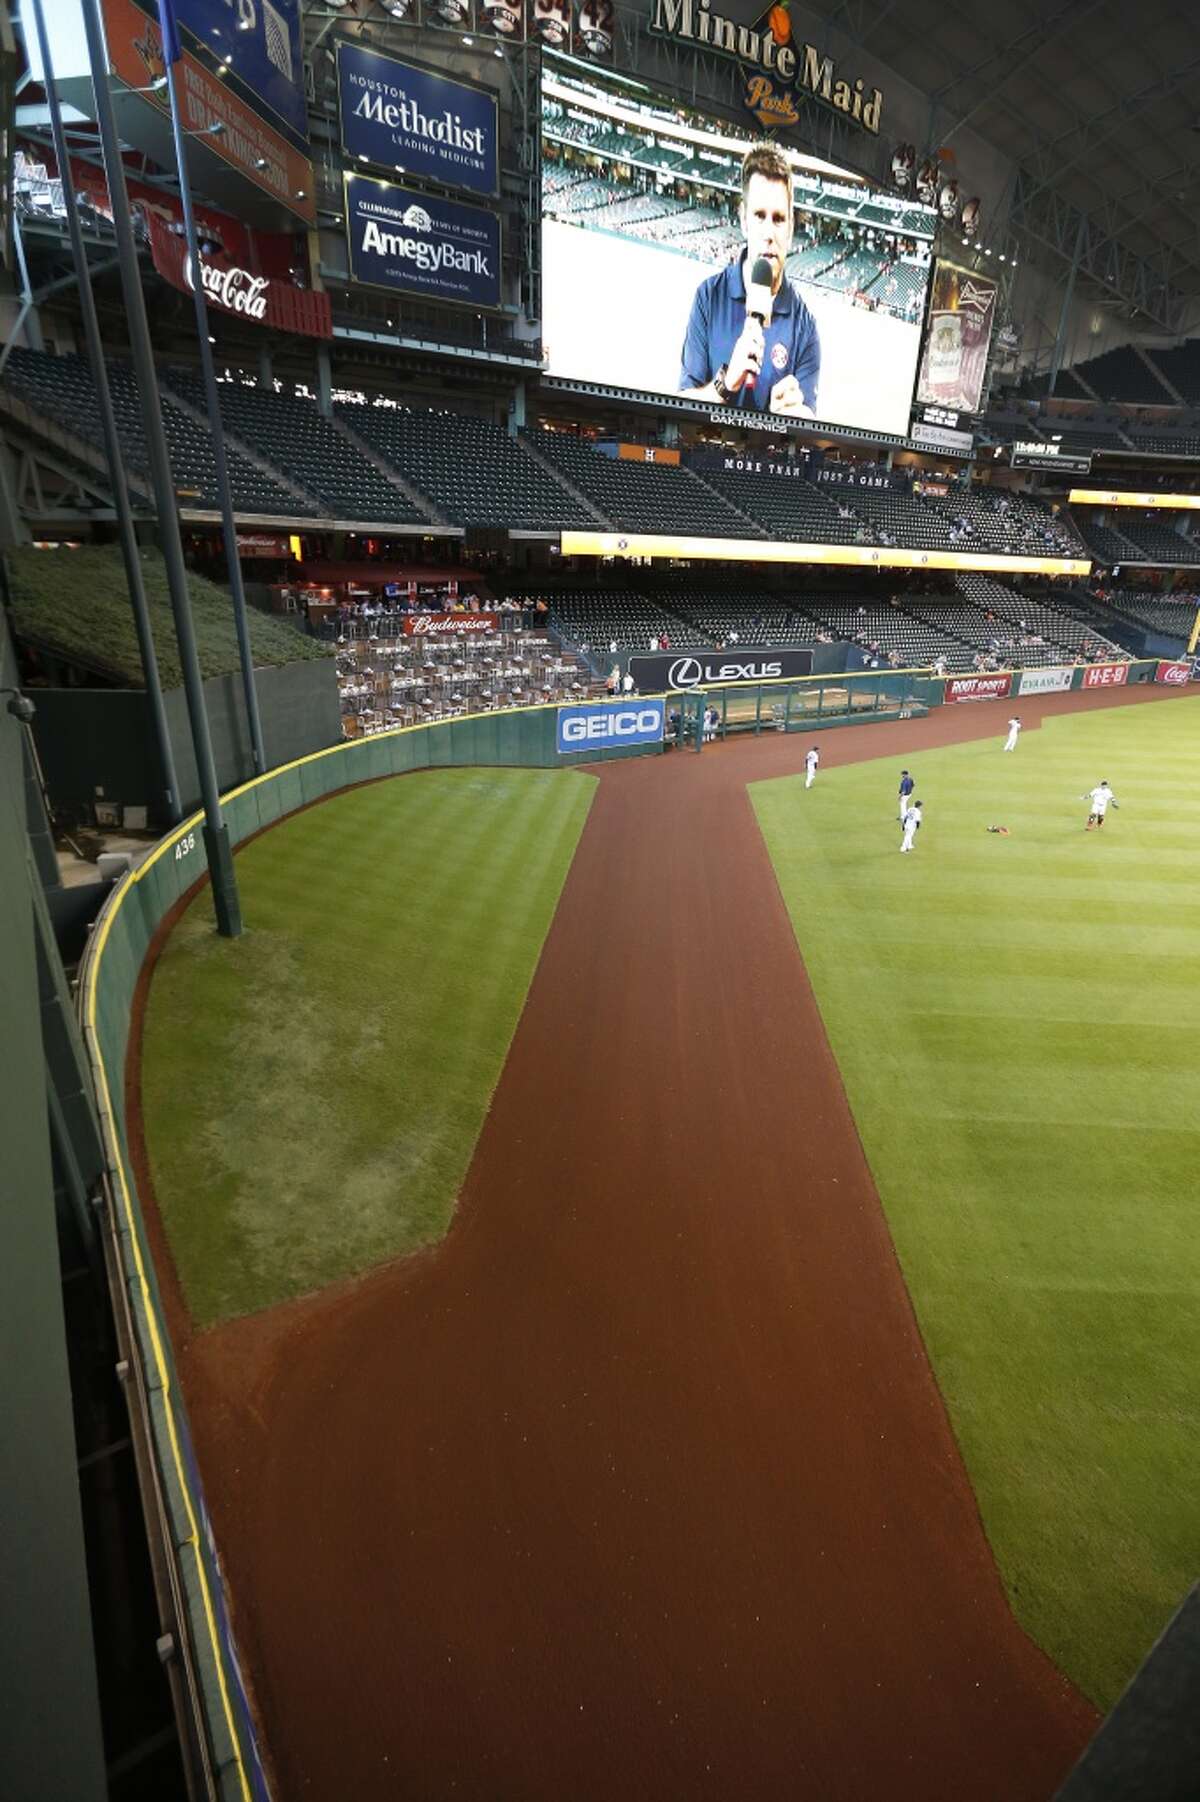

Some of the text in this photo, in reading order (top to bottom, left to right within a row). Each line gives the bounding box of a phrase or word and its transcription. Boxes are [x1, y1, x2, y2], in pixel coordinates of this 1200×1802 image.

[652, 0, 883, 135] Minute Maid
[349, 72, 407, 101] HOUSTON
[745, 75, 798, 122] Park
[352, 90, 486, 156] Methodist
[391, 133, 486, 170] LEADING MEDICINE
[362, 220, 490, 275] AmegyBank
[710, 414, 788, 434] DAKTRONICS
[724, 458, 762, 473] MORE
[817, 470, 844, 483] JUST
[848, 475, 855, 484] A
[409, 613, 493, 632] Budweiser
[705, 662, 782, 681] LEXUS
[951, 679, 979, 694] ROOT
[562, 709, 661, 742] GEICO
